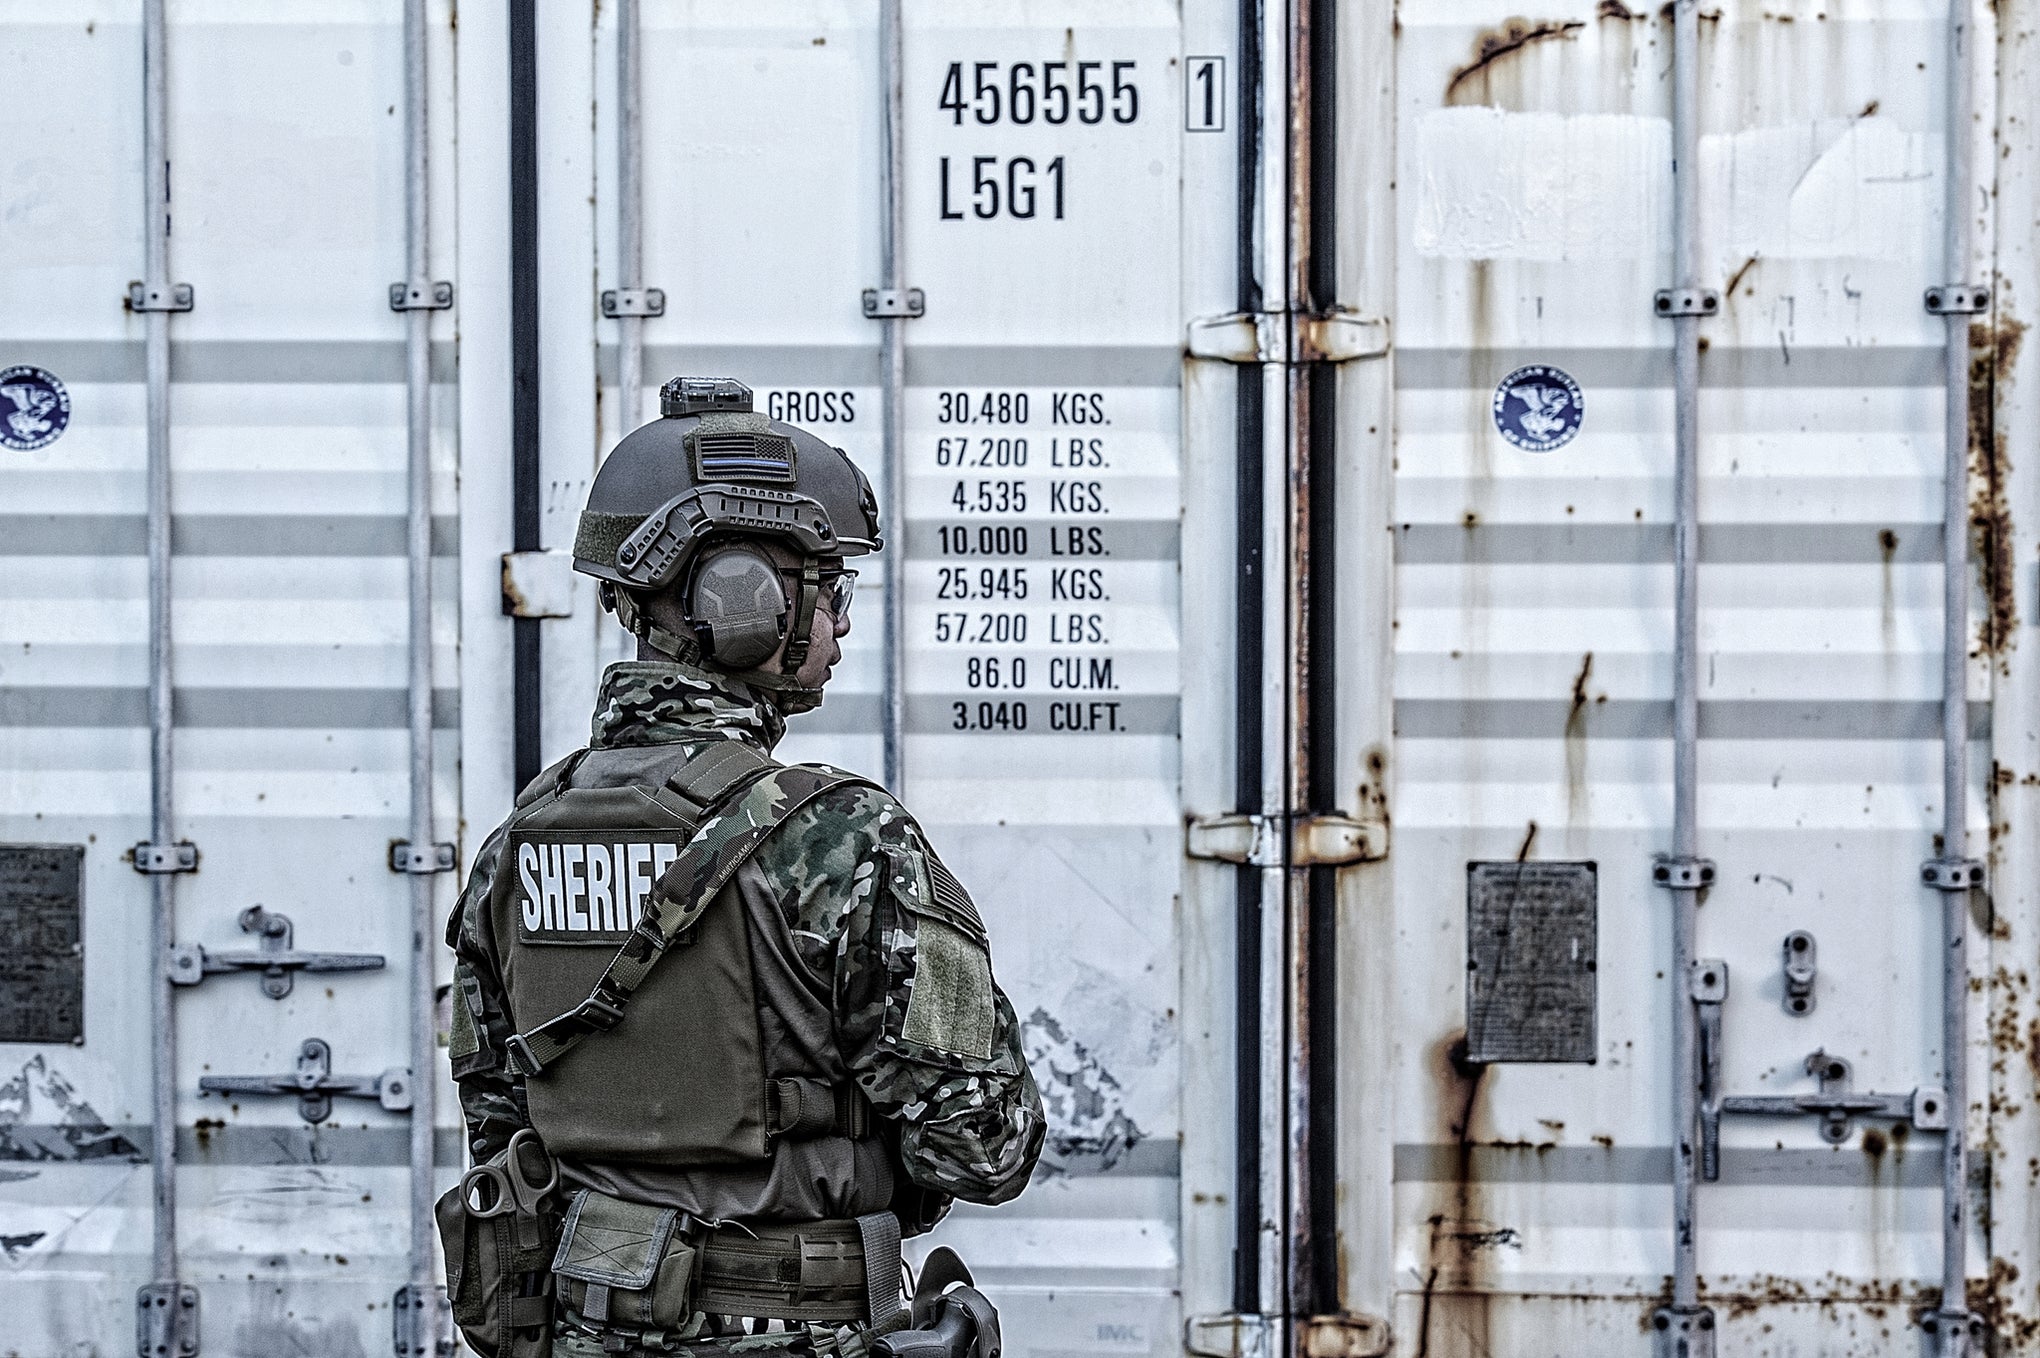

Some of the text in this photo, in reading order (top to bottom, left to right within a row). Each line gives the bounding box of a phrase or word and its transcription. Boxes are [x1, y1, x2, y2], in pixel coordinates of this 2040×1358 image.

[939, 61, 1215, 126] 456555 1
[939, 156, 1065, 220] L5G1
[768, 391, 1112, 424] GROSS 30,480 KGS.
[936, 438, 1111, 467] 67,200 LBS.
[952, 481, 1110, 513] 4,535 KGS.
[937, 525, 1110, 556] 10,000 LBS.
[937, 568, 1111, 600] 25,945 KGS.
[935, 613, 1110, 643] 57,200 LBS.
[968, 657, 1120, 689] 86.0 CU.M.
[952, 701, 1126, 732] 3,040 CU.FT.
